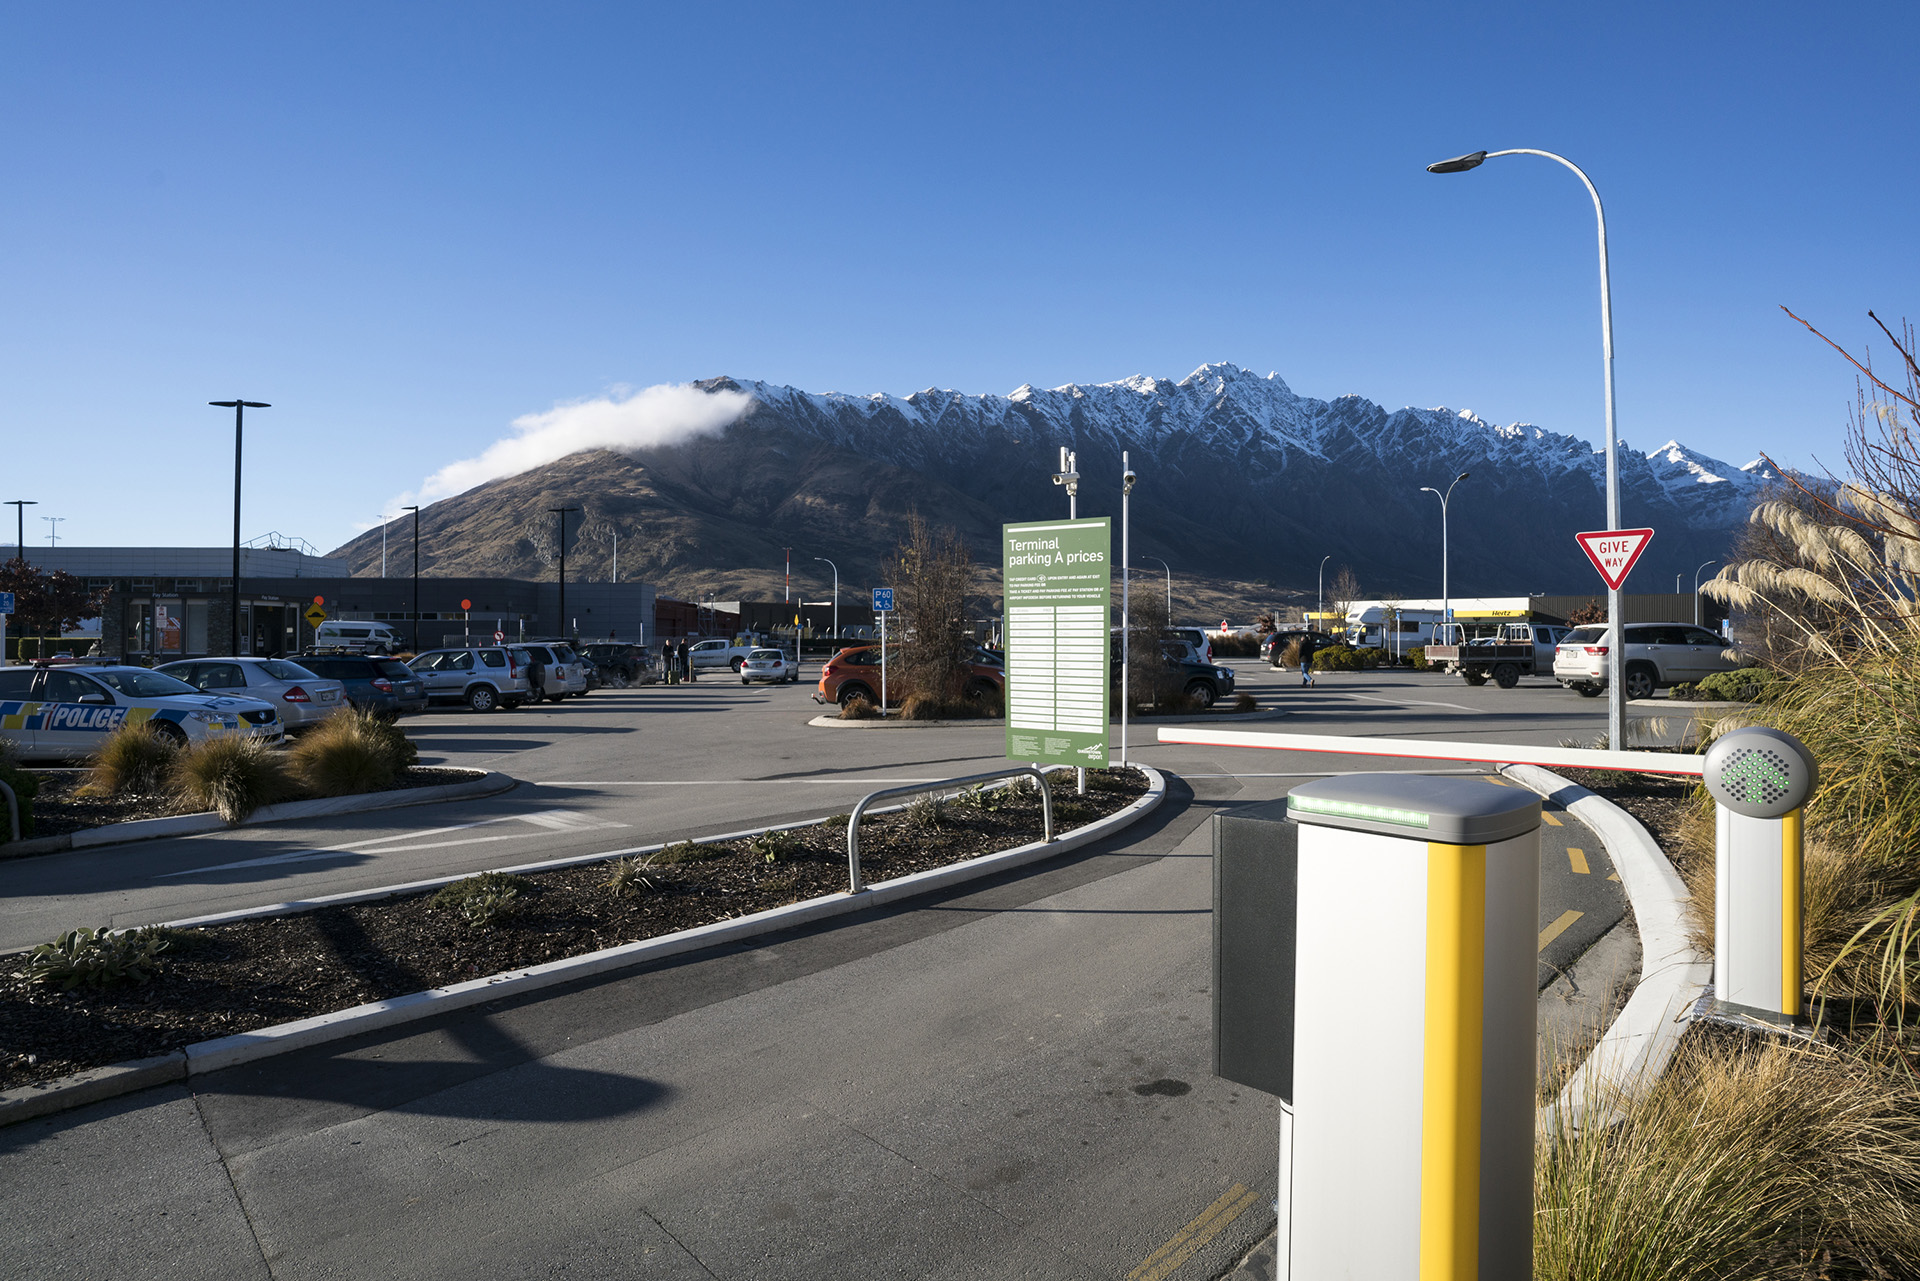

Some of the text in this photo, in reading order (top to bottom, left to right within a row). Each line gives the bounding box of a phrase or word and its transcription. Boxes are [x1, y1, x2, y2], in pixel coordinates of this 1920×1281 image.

[1009, 537, 1059, 551] Terminal
[1600, 541, 1628, 554] GIVE
[1009, 550, 1104, 568] parking A prices
[1605, 558, 1624, 568] WAY
[53, 708, 125, 728] POLICE
